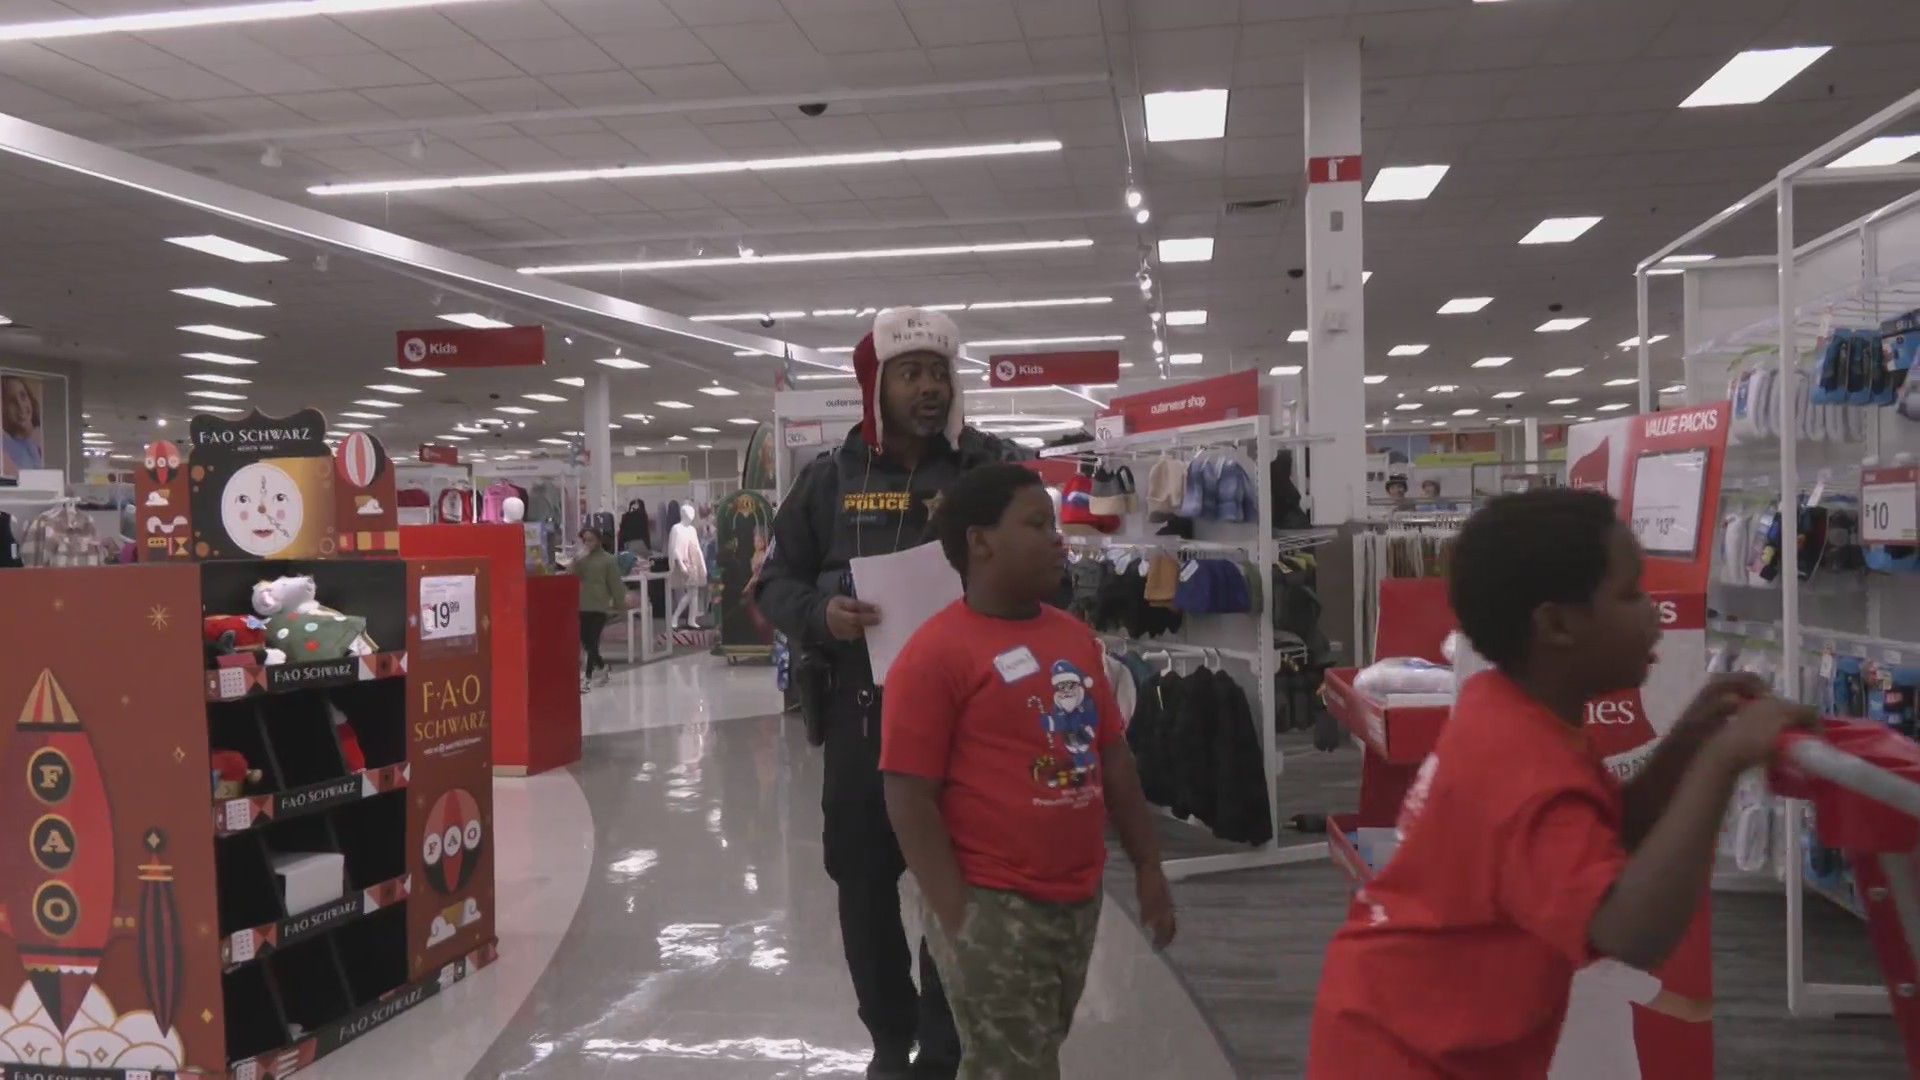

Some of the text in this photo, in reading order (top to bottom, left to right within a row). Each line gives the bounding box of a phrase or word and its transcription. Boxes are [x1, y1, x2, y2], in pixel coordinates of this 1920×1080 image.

[429, 343, 458, 354] Kids
[1019, 364, 1044, 375] Kids
[1187, 395, 1206, 408] shop
[1645, 409, 1718, 438] VALUE PACKS
[239, 426, 312, 442] SCHWARZ
[844, 498, 909, 511] POLICE
[303, 663, 352, 680] SCHWARZ
[414, 710, 486, 742] SCHWARZ
[308, 781, 356, 803] SCHWARZ
